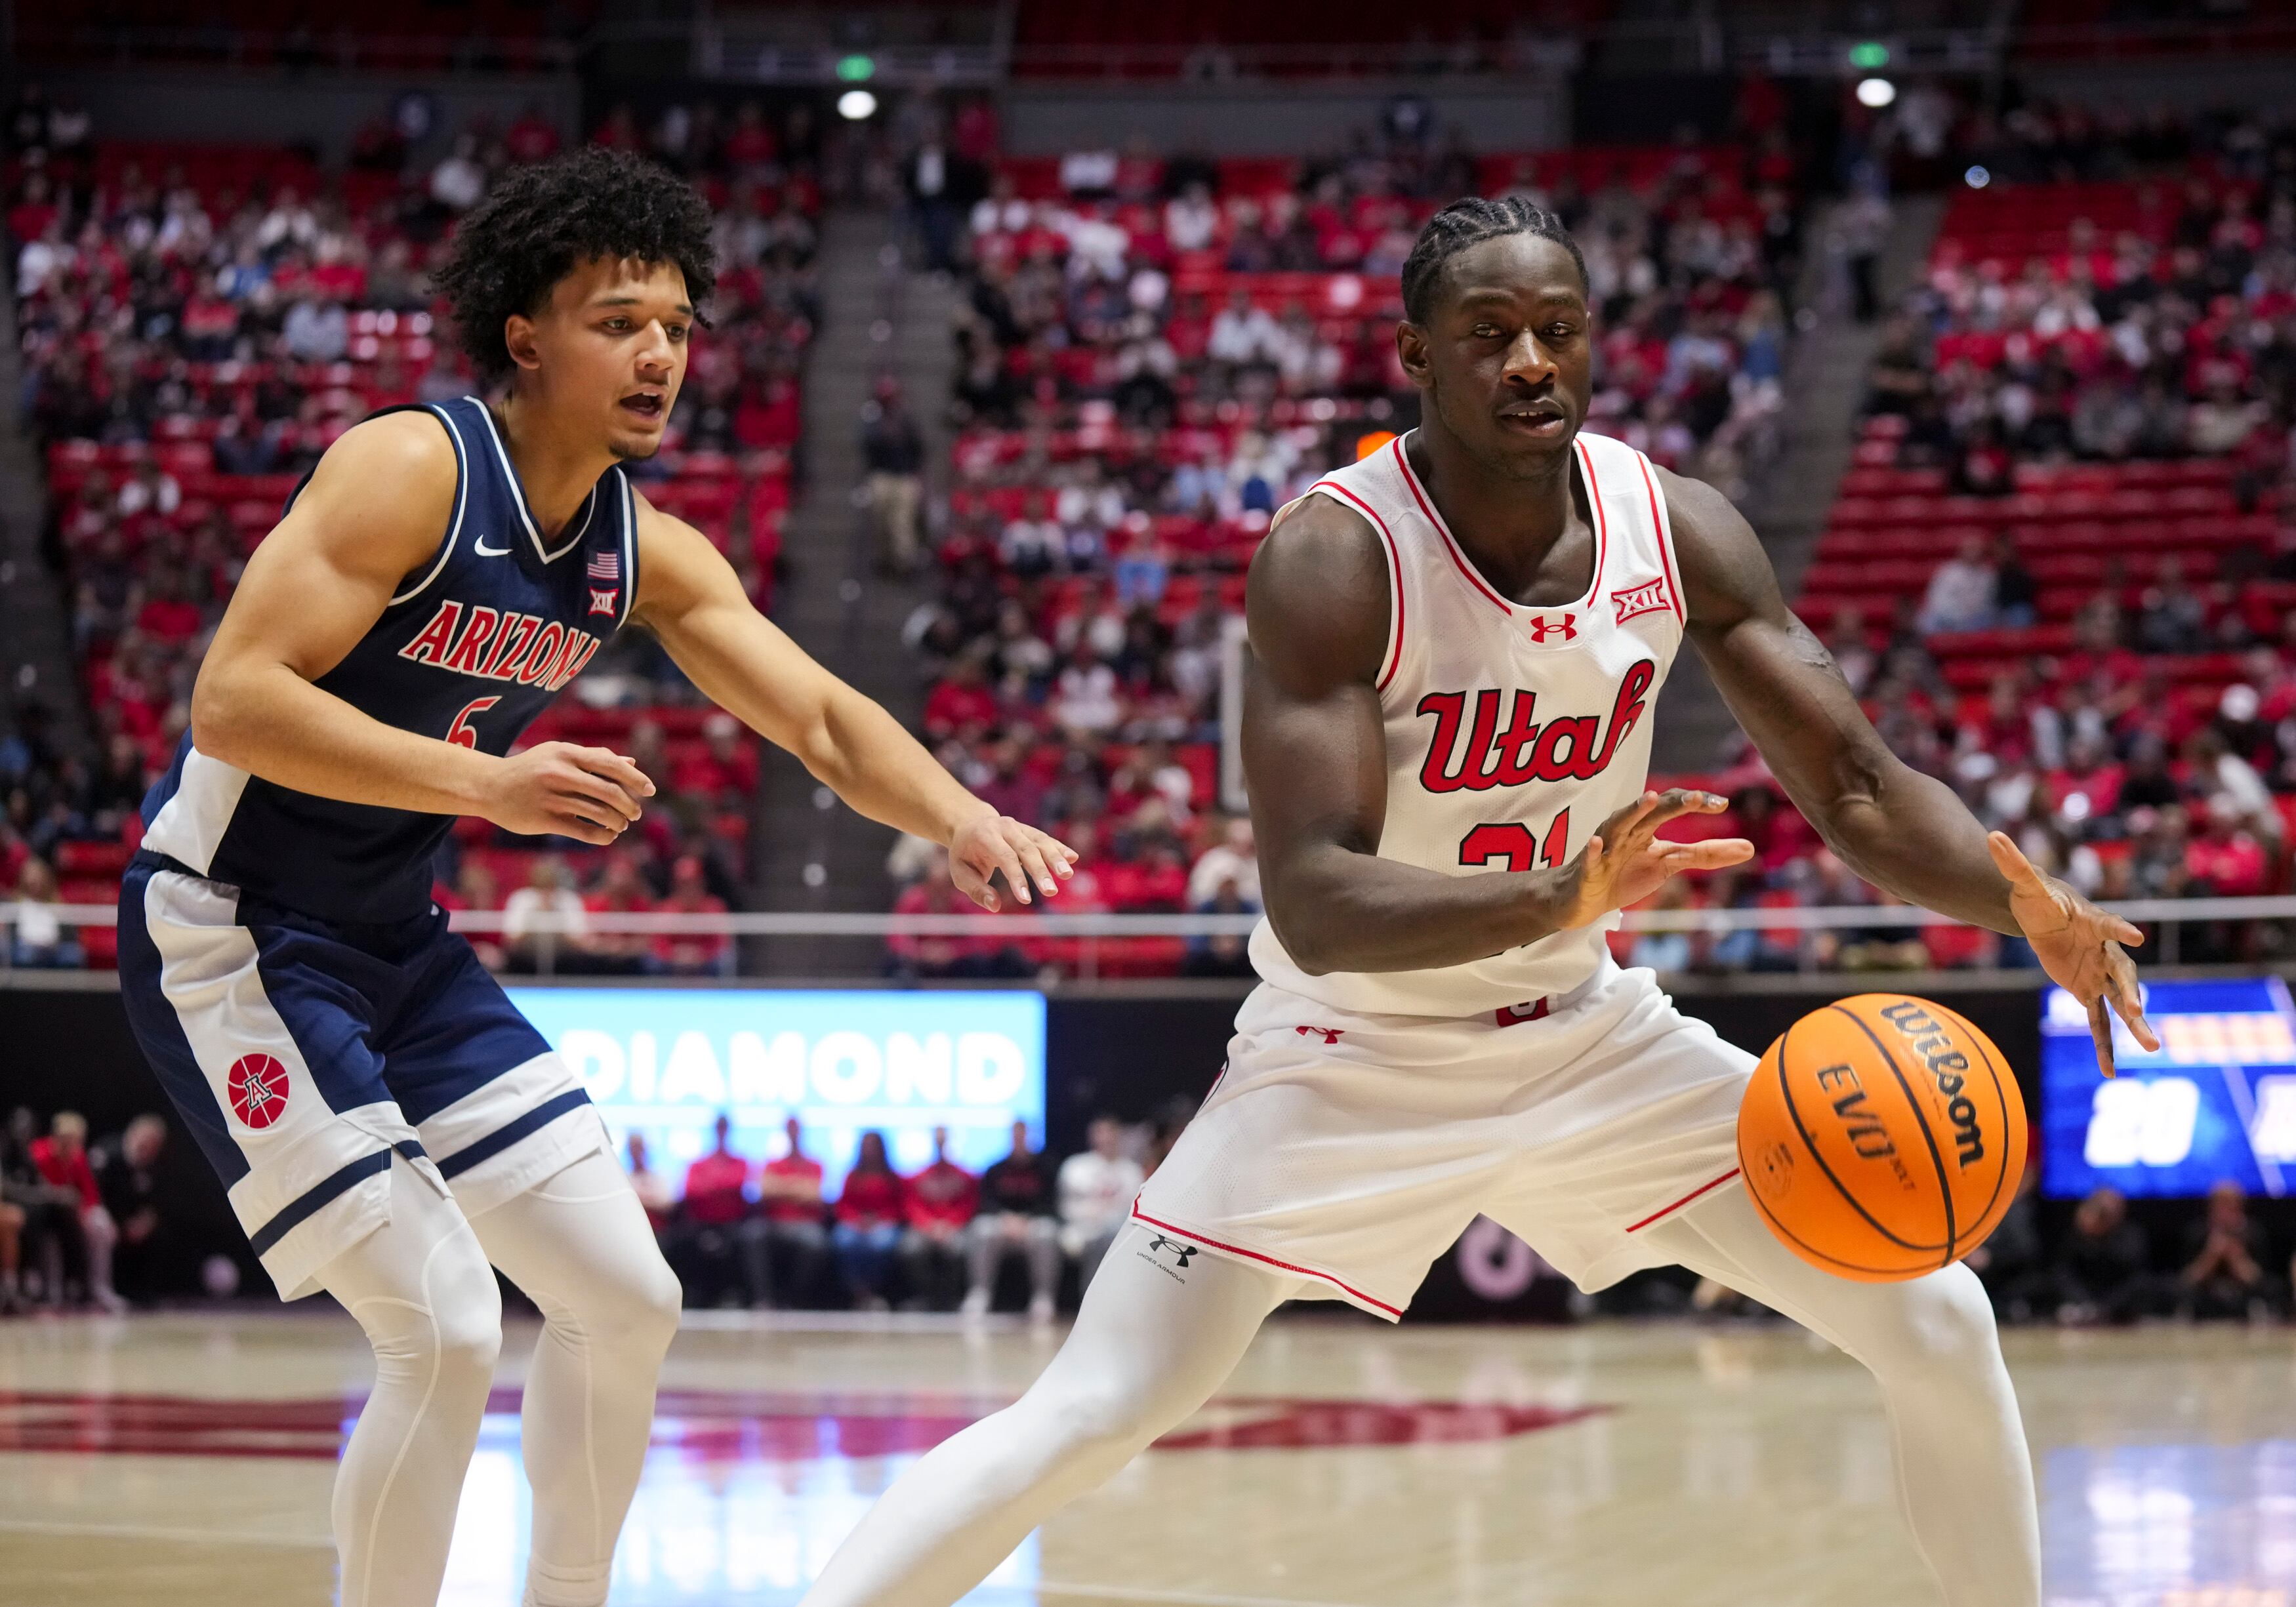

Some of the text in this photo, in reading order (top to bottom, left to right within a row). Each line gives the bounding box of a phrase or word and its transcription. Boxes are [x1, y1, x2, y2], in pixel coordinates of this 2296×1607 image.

[1611, 577, 1671, 626] XII
[397, 599, 602, 692] ARIZONA
[445, 695, 503, 750] 6
[1416, 659, 1655, 794] Utah
[559, 1029, 1025, 1105] DIAMOND
[1879, 1001, 1984, 1171] Wilson
[1136, 1251, 1185, 1285] UNDER ARMOUR
